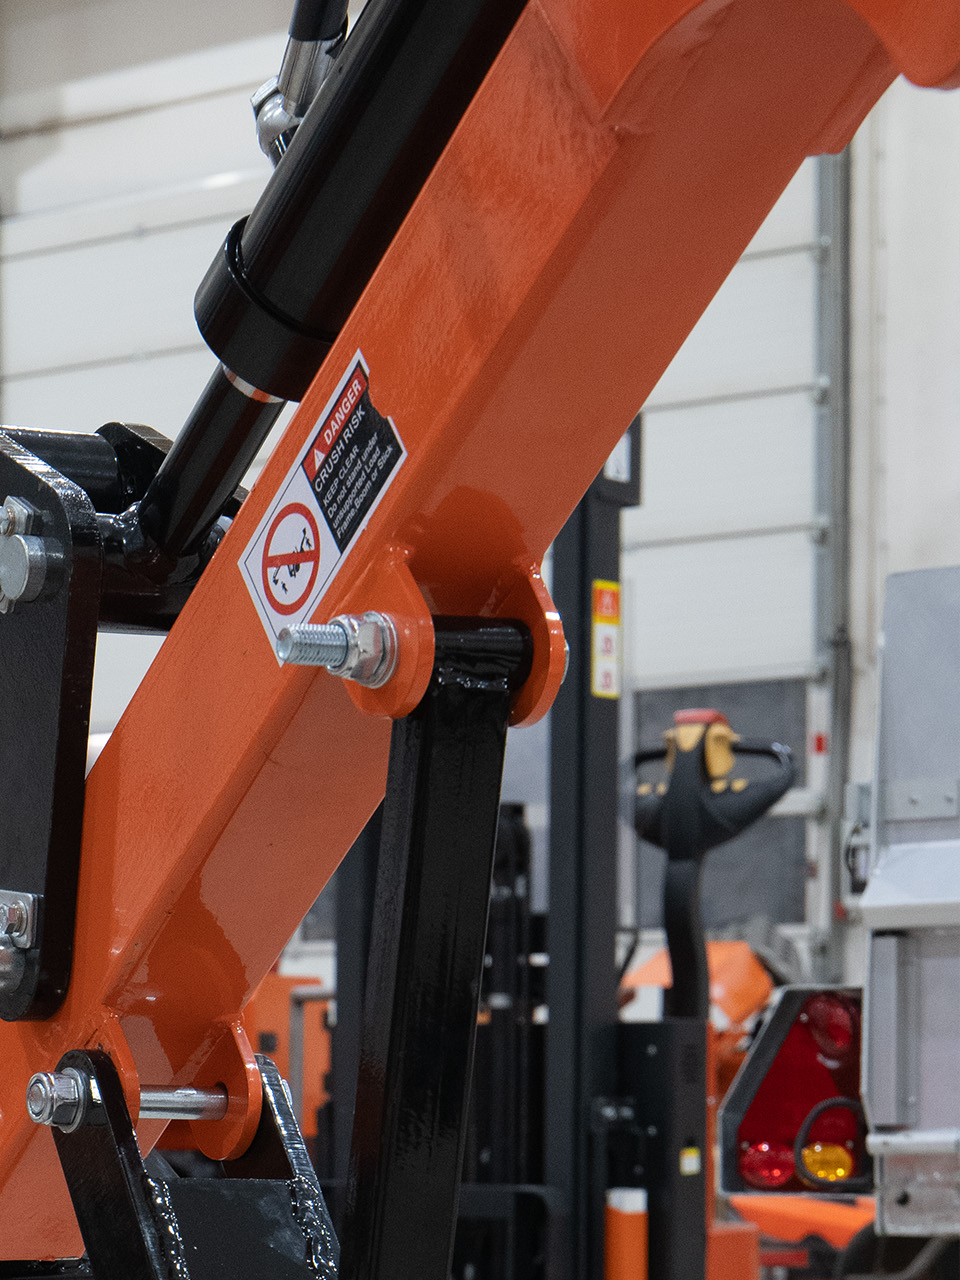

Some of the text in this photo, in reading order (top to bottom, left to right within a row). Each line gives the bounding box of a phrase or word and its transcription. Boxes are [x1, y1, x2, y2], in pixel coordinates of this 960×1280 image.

[314, 404, 366, 493] CRUSH RISK
[323, 378, 362, 445] DANGER
[322, 444, 360, 508] KEEP CLEAR
[327, 431, 379, 519] Do not stand under
[332, 447, 381, 529] unsupported Load
[370, 469, 379, 482] or
[377, 443, 394, 471] Stick
